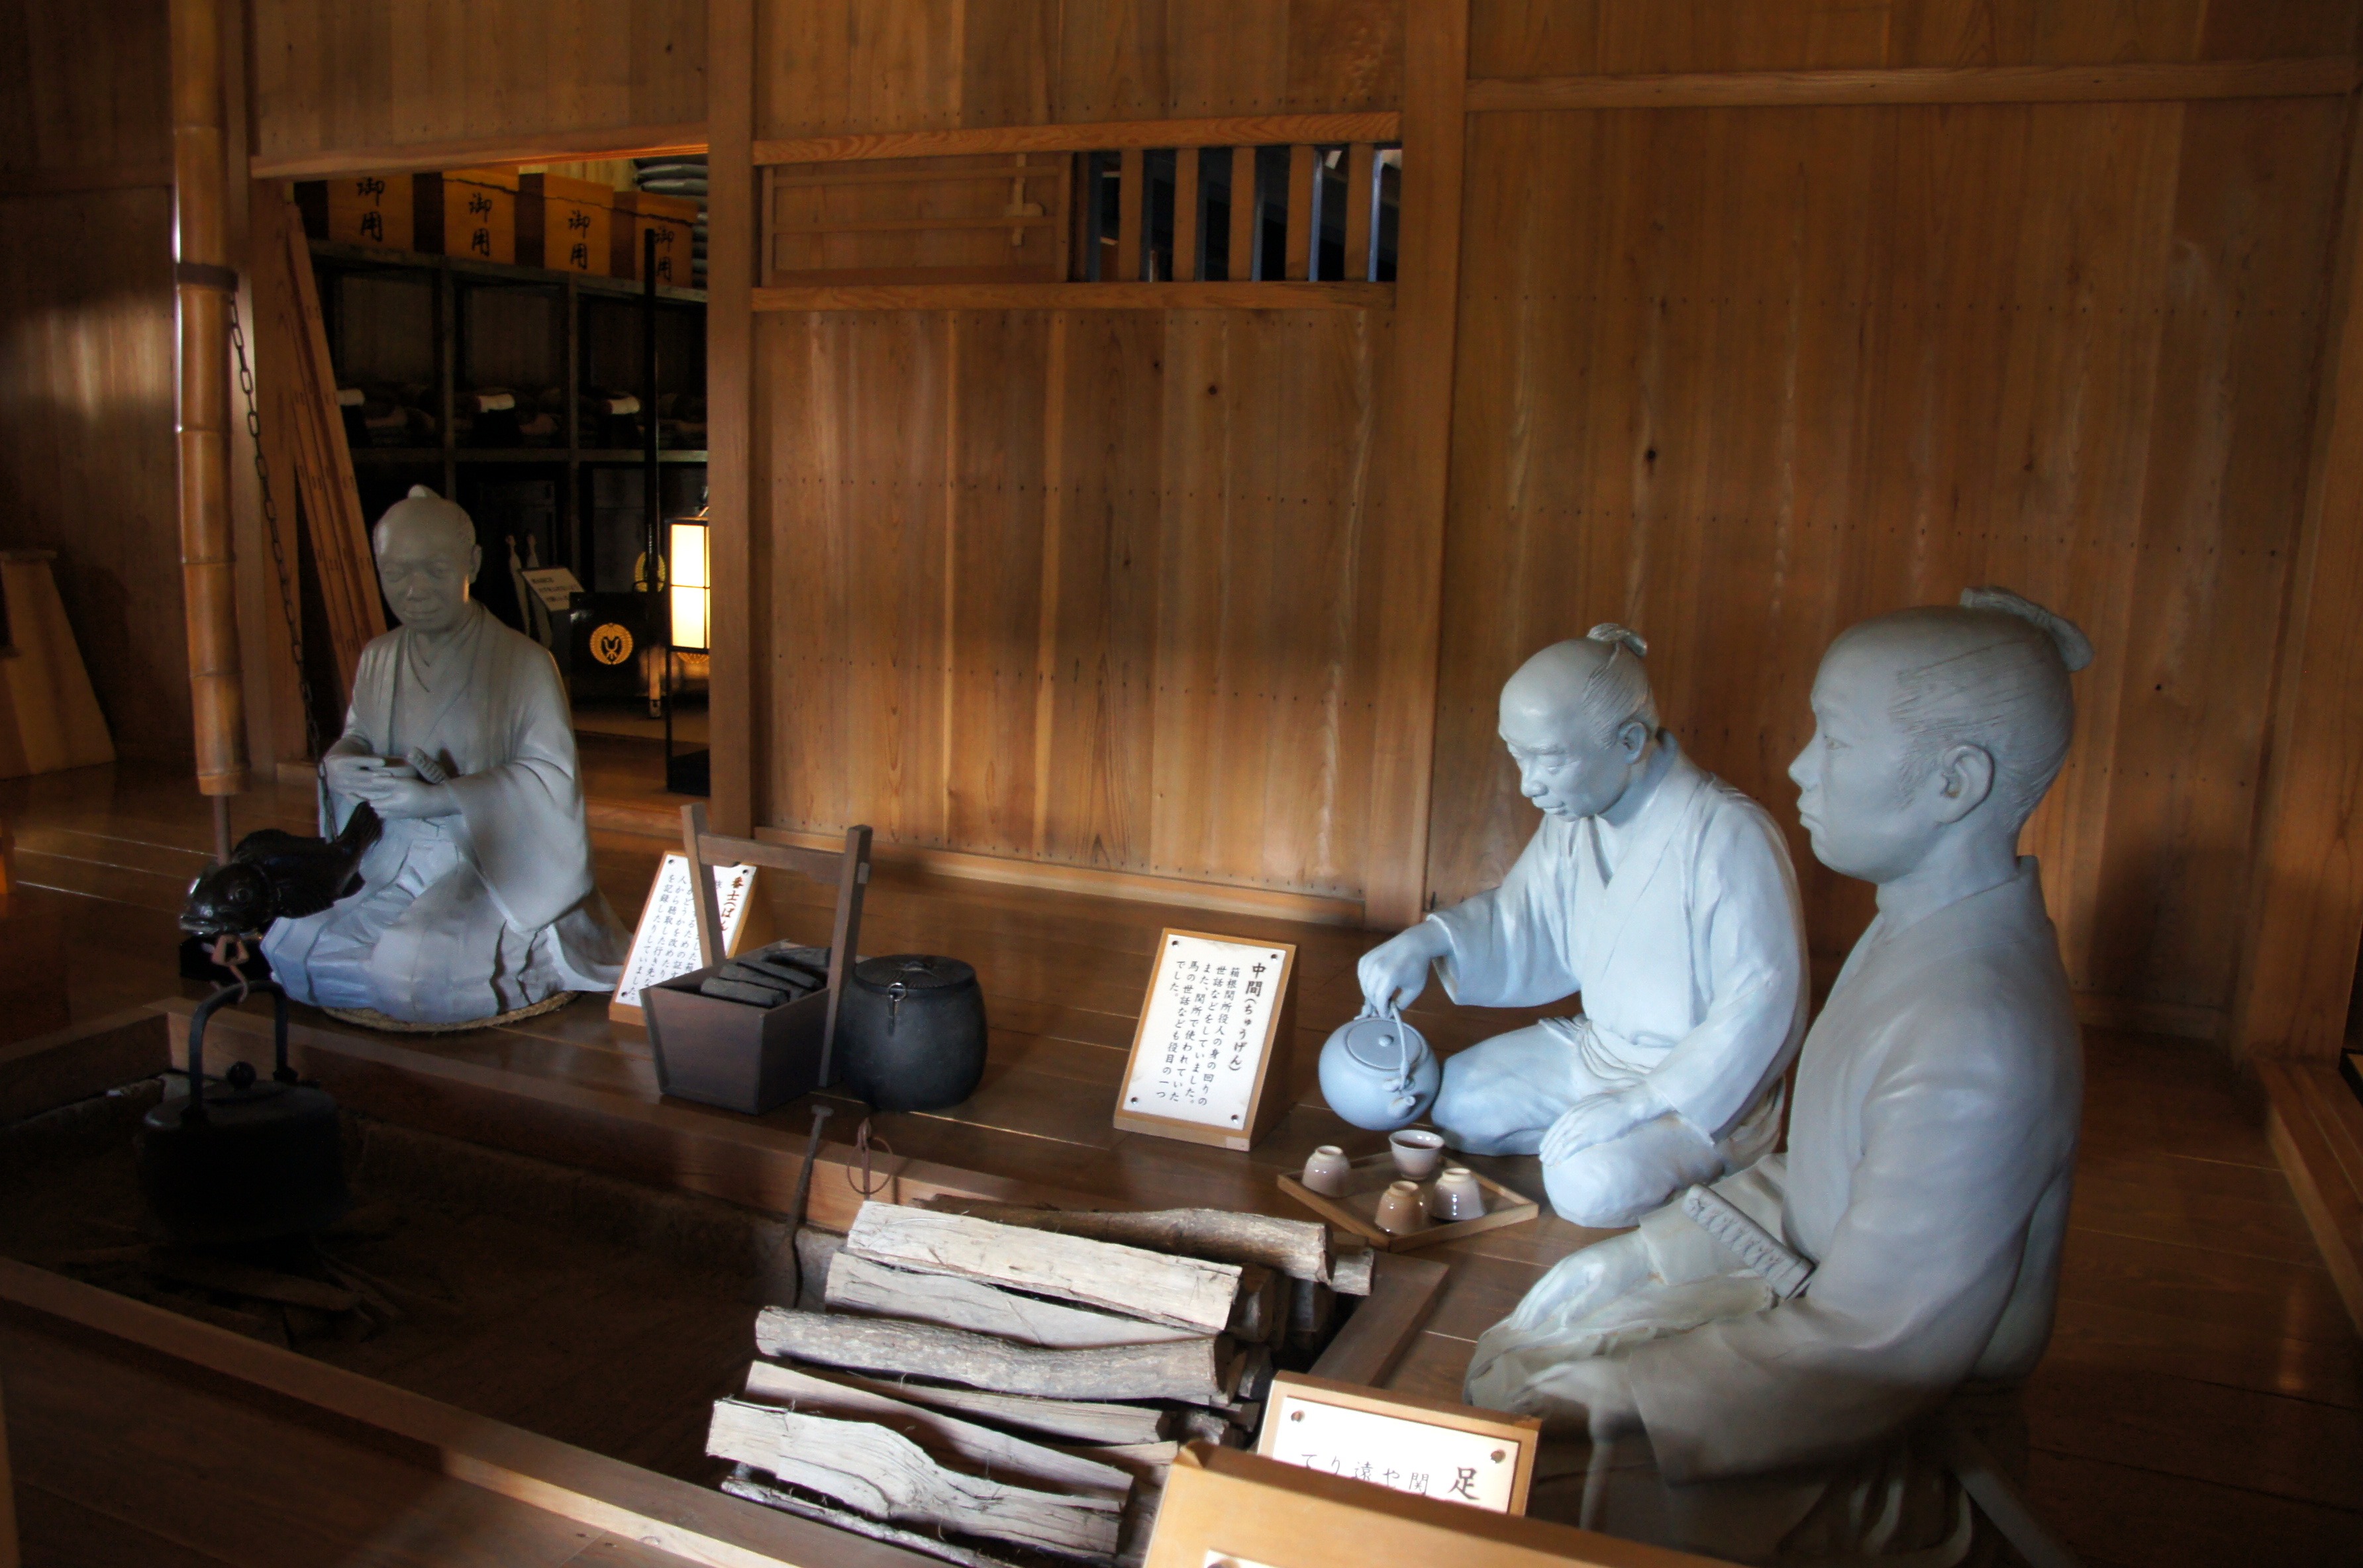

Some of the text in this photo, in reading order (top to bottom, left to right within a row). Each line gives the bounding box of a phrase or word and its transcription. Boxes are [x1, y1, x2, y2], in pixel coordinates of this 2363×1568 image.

[356, 176, 384, 242] 御用
[468, 193, 492, 257] 御用
[568, 209, 590, 270] 御用
[653, 226, 674, 281] 御用
[1169, 961, 1185, 997] でした。
[1157, 961, 1199, 1099] 馬の世話なども役目の一つ
[1170, 963, 1211, 1102] また、関所で使われていた
[1185, 966, 1227, 1104] 世話などをしていました。
[1198, 967, 1240, 1105] 箱根関所役人の身の回りの
[1448, 1467, 1480, 1500] 足
